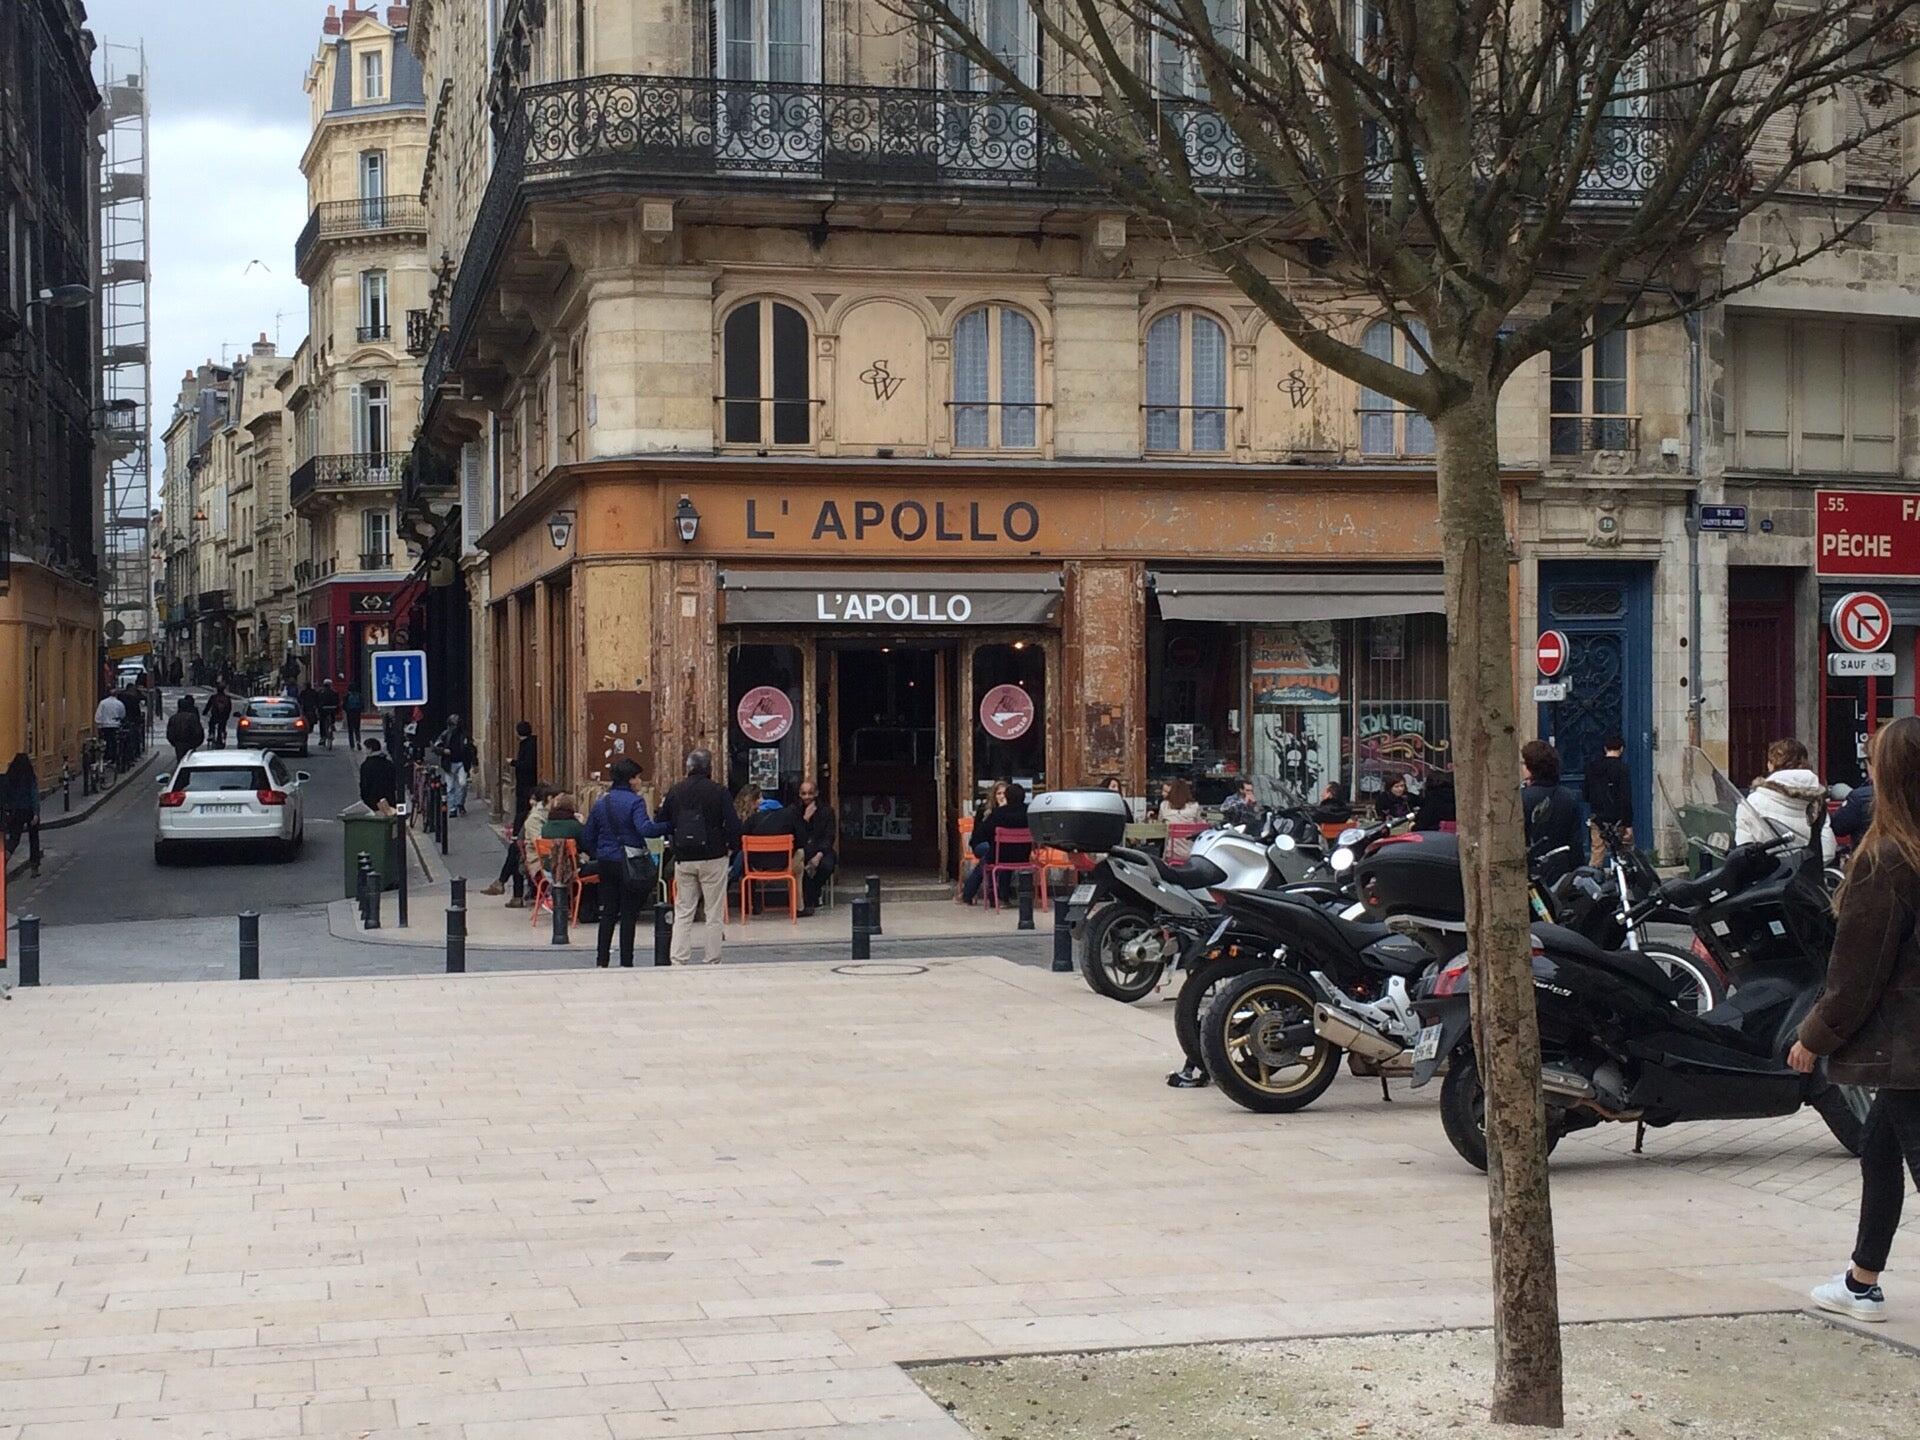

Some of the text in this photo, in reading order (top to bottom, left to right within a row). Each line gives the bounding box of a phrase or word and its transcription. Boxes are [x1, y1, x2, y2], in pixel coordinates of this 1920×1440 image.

[811, 500, 1040, 542] APOLLO
[1822, 528, 1892, 557] PÊCHE
[1841, 660, 1866, 669] SAUF
